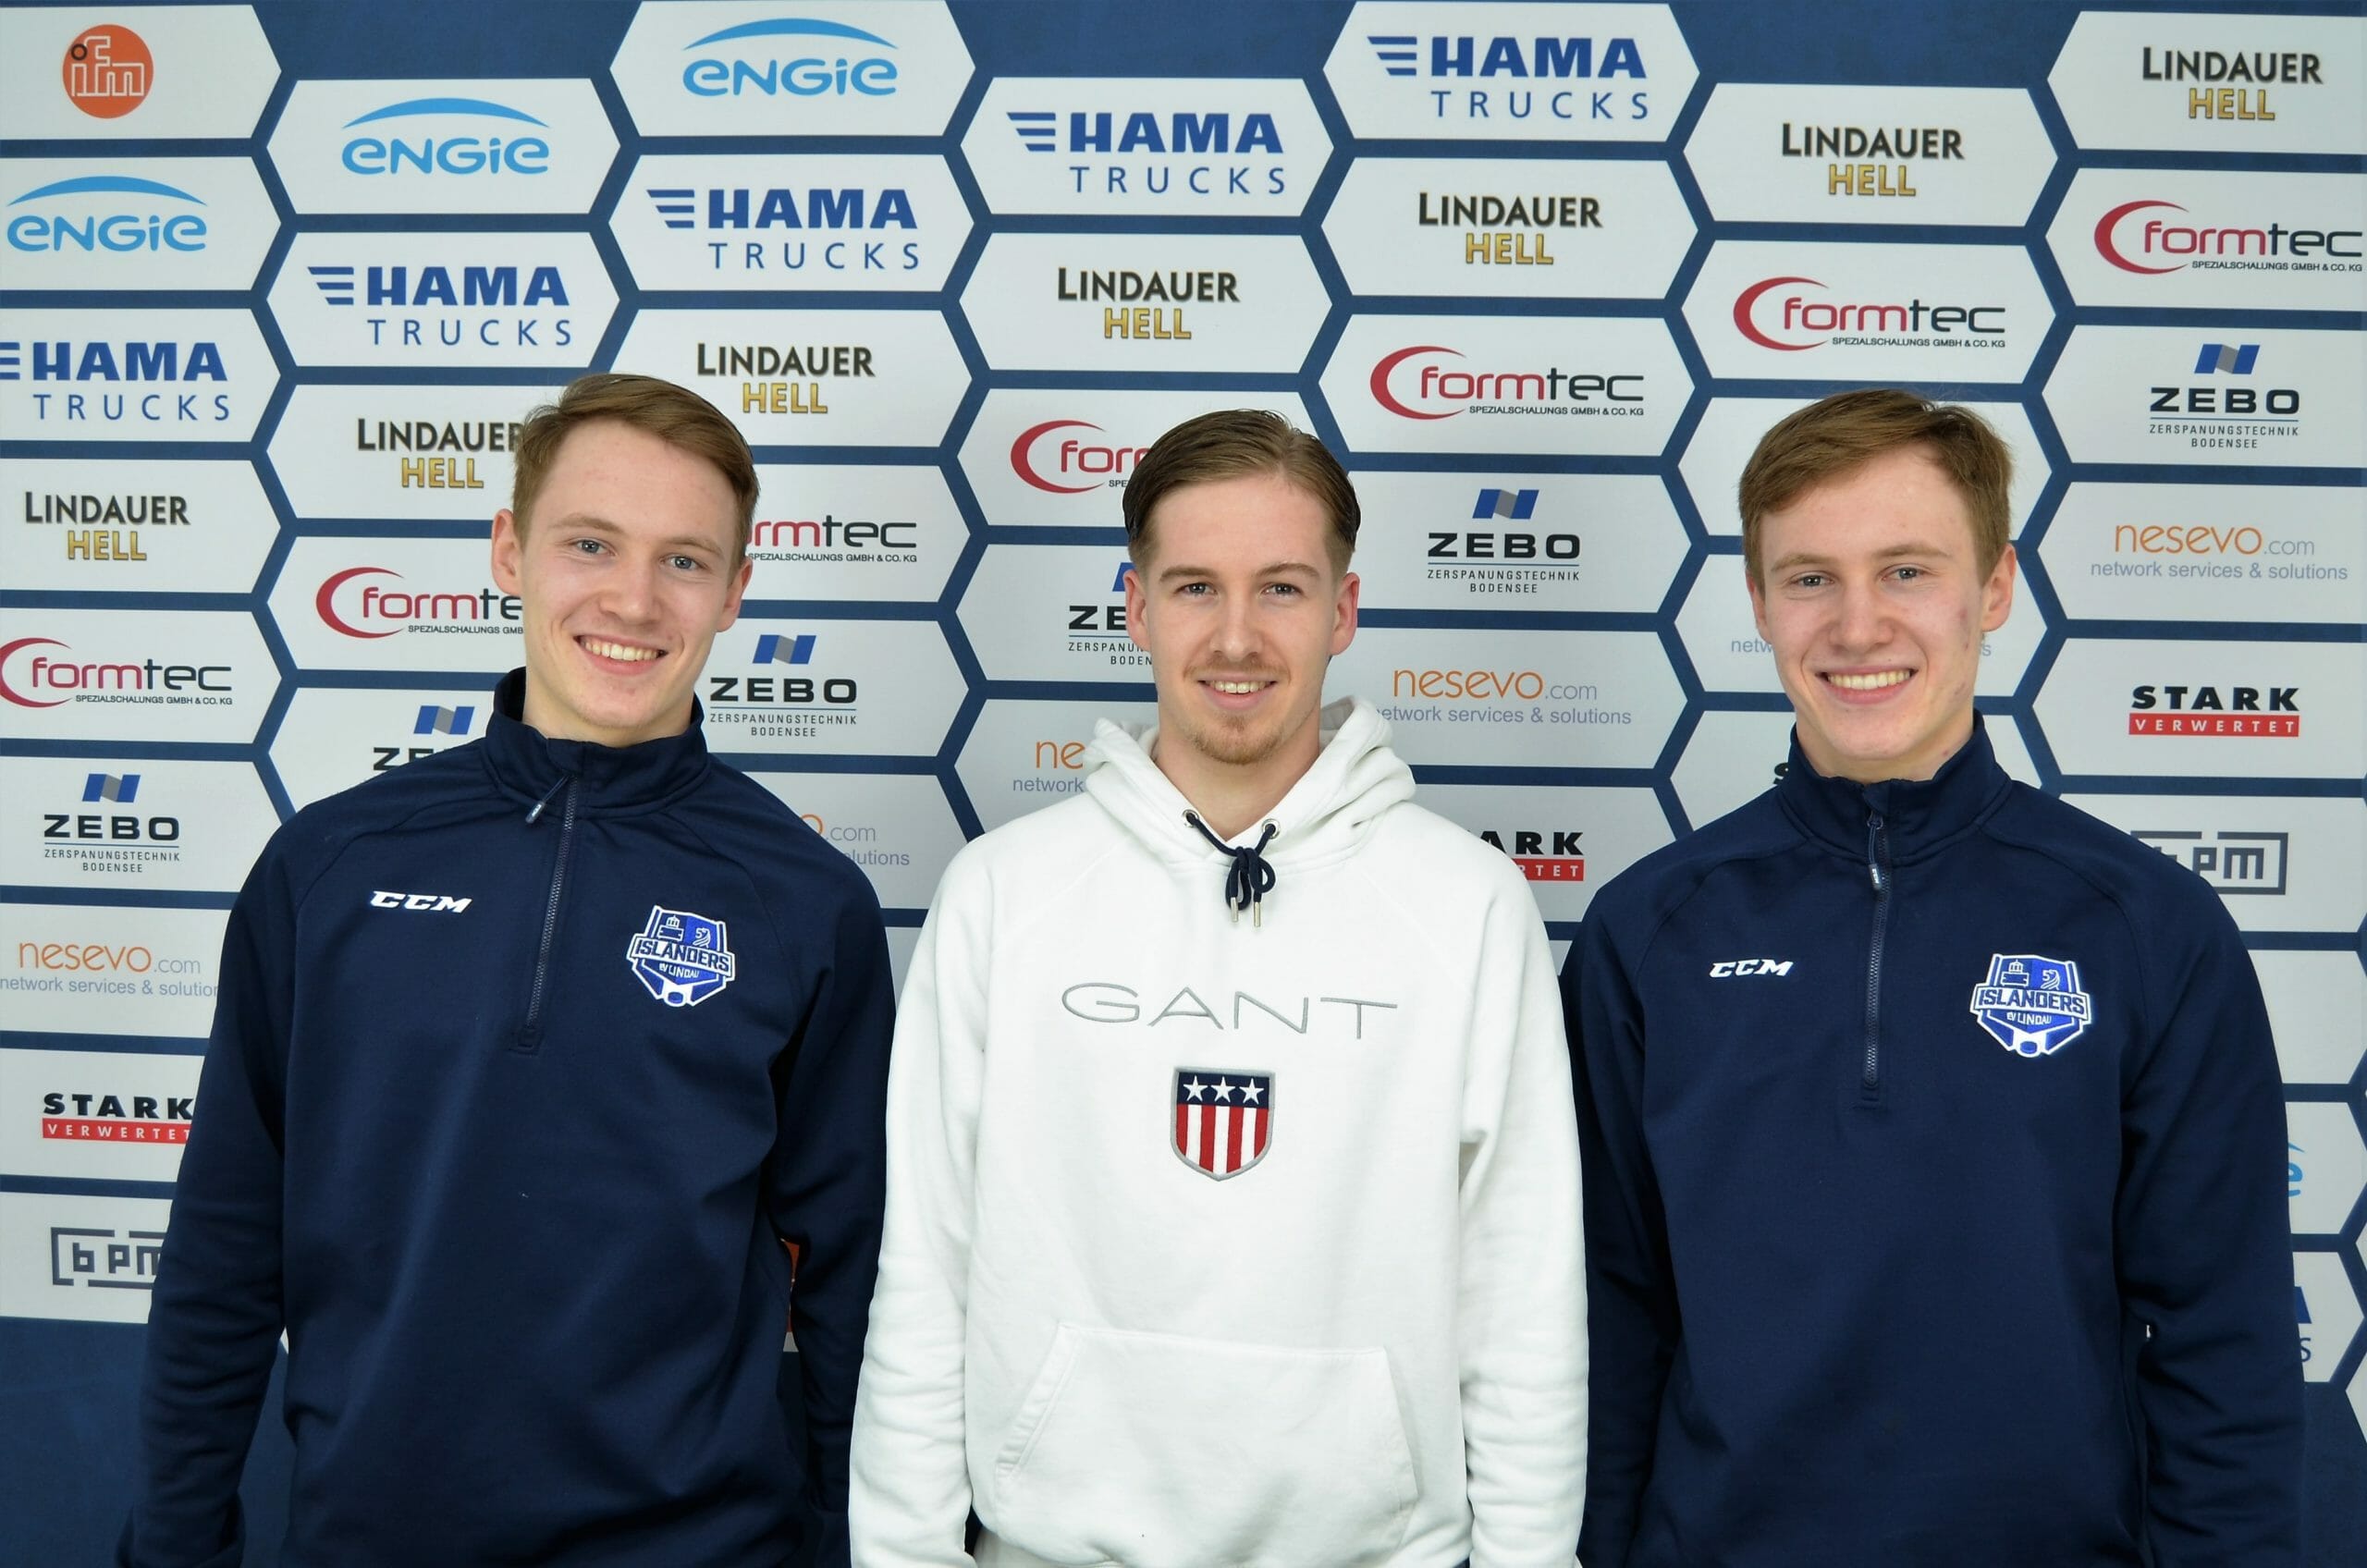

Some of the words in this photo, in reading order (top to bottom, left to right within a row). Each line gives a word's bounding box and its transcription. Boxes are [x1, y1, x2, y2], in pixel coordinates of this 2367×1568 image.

[1431, 37, 1646, 79] HAMA
[2143, 47, 2323, 84] LINDAUER
[1431, 91, 1648, 119] TRUCKS
[2189, 88, 2275, 121] HELL
[1070, 113, 1283, 153] HAMA
[1783, 123, 1964, 159] LINDAUER
[1070, 166, 1284, 194] TRUCKS
[1829, 164, 1916, 197] HELL
[708, 189, 917, 229] HAMA
[1419, 192, 1602, 227] LINDAUER
[1466, 233, 1554, 265] HELL
[2145, 221, 2362, 257] formtec
[708, 242, 918, 269] TRUCKS
[2191, 260, 2289, 271] SPEZIALSCHALUNGS
[2290, 262, 2321, 272] GMBH
[2321, 263, 2329, 272] &
[2330, 263, 2348, 272] CO.
[2348, 263, 2363, 273] KG
[367, 266, 570, 306] HAMA
[1059, 268, 1240, 302] LINDAUER
[1104, 308, 1192, 340] HELL
[1784, 298, 2005, 333] formtec
[367, 320, 570, 346] TRUCKS
[1832, 337, 1931, 347] SPEZIALSCHALUNGS
[1932, 338, 1963, 348] GMBH
[1964, 339, 1972, 348] &
[1972, 339, 1990, 349] CO.
[1991, 339, 2006, 349] KG
[33, 342, 227, 381] HAMA
[698, 343, 875, 376] LINDAUER
[1421, 366, 1644, 401] formtec
[33, 394, 228, 421] TRUCKS
[742, 383, 828, 414] HELL
[1469, 405, 1569, 415] SPEZIALSCHALUNGS
[1570, 407, 1600, 416] GMBH
[1601, 407, 1610, 416] &
[1611, 407, 1629, 416] CO.
[1629, 407, 1645, 416] KG
[2151, 387, 2300, 414] ZEBO
[2150, 424, 2298, 435] ZERSPANUNGSTECHNIK
[2190, 437, 2258, 449] BODENSEE
[401, 458, 484, 488] HELL
[26, 492, 190, 525] LINDAUER
[747, 514, 917, 548] rmtec
[2116, 525, 2314, 555] nesevo.com
[67, 530, 147, 561] HELL
[845, 553, 875, 562] GMBH
[876, 554, 884, 563] &
[884, 554, 902, 563] CO.
[902, 554, 918, 563] KG
[1428, 533, 1580, 558] ZEBO
[1428, 570, 1578, 581] ZERSPANUNGSTECHNIK
[2091, 561, 2162, 577] network
[2169, 562, 2242, 578] services
[2249, 562, 2262, 578] &
[2268, 563, 2348, 580] solutions
[1469, 582, 1538, 594] BODENSEE
[362, 586, 523, 620] formte
[408, 624, 501, 634] SPEZIALSCHALUNGS
[502, 626, 523, 634] GMB
[1069, 606, 1126, 631] ZE
[1110, 655, 1152, 666] BODEN
[1731, 640, 1772, 654] netw
[32, 657, 231, 691] formtec
[1394, 670, 1597, 700] nesevo.com
[75, 694, 165, 704] SPEZIALSCHALUNGS
[166, 695, 193, 704] GMBH
[194, 696, 202, 704] &
[202, 696, 218, 705] CO.
[219, 697, 233, 705] KG
[710, 678, 856, 704] ZEBO
[2132, 686, 2299, 711] STARK
[710, 714, 856, 725] ZERSPANUNGSTECHNIK
[1376, 705, 1441, 721] etwork
[1448, 706, 1524, 723] services
[1531, 707, 1543, 723] &
[1550, 708, 1631, 724] solutions
[2135, 718, 2295, 734] VERWERTET
[751, 726, 816, 738] BODENSEE
[1012, 777, 1085, 792] network
[44, 815, 178, 840] ZEBO
[44, 849, 179, 861] ZERSPANUNGSTECHNIK
[1479, 830, 1584, 855] ARK
[82, 862, 143, 874] BODENSEE
[2154, 846, 2264, 879] pm
[370, 890, 472, 913] CCM
[19, 943, 200, 973] nesevo.com
[635, 938, 730, 972] ISLANDERS
[1709, 958, 1794, 978] CCM
[668, 964, 700, 978] LINDAU
[0, 976, 63, 991] network
[68, 978, 136, 994] services
[141, 980, 153, 995] &
[159, 982, 217, 997] solutio
[1061, 982, 1398, 1039] GANT
[1979, 988, 2085, 1015] ISLANDERS
[2017, 1012, 2052, 1025] LINDAU
[43, 1093, 193, 1120] STARK
